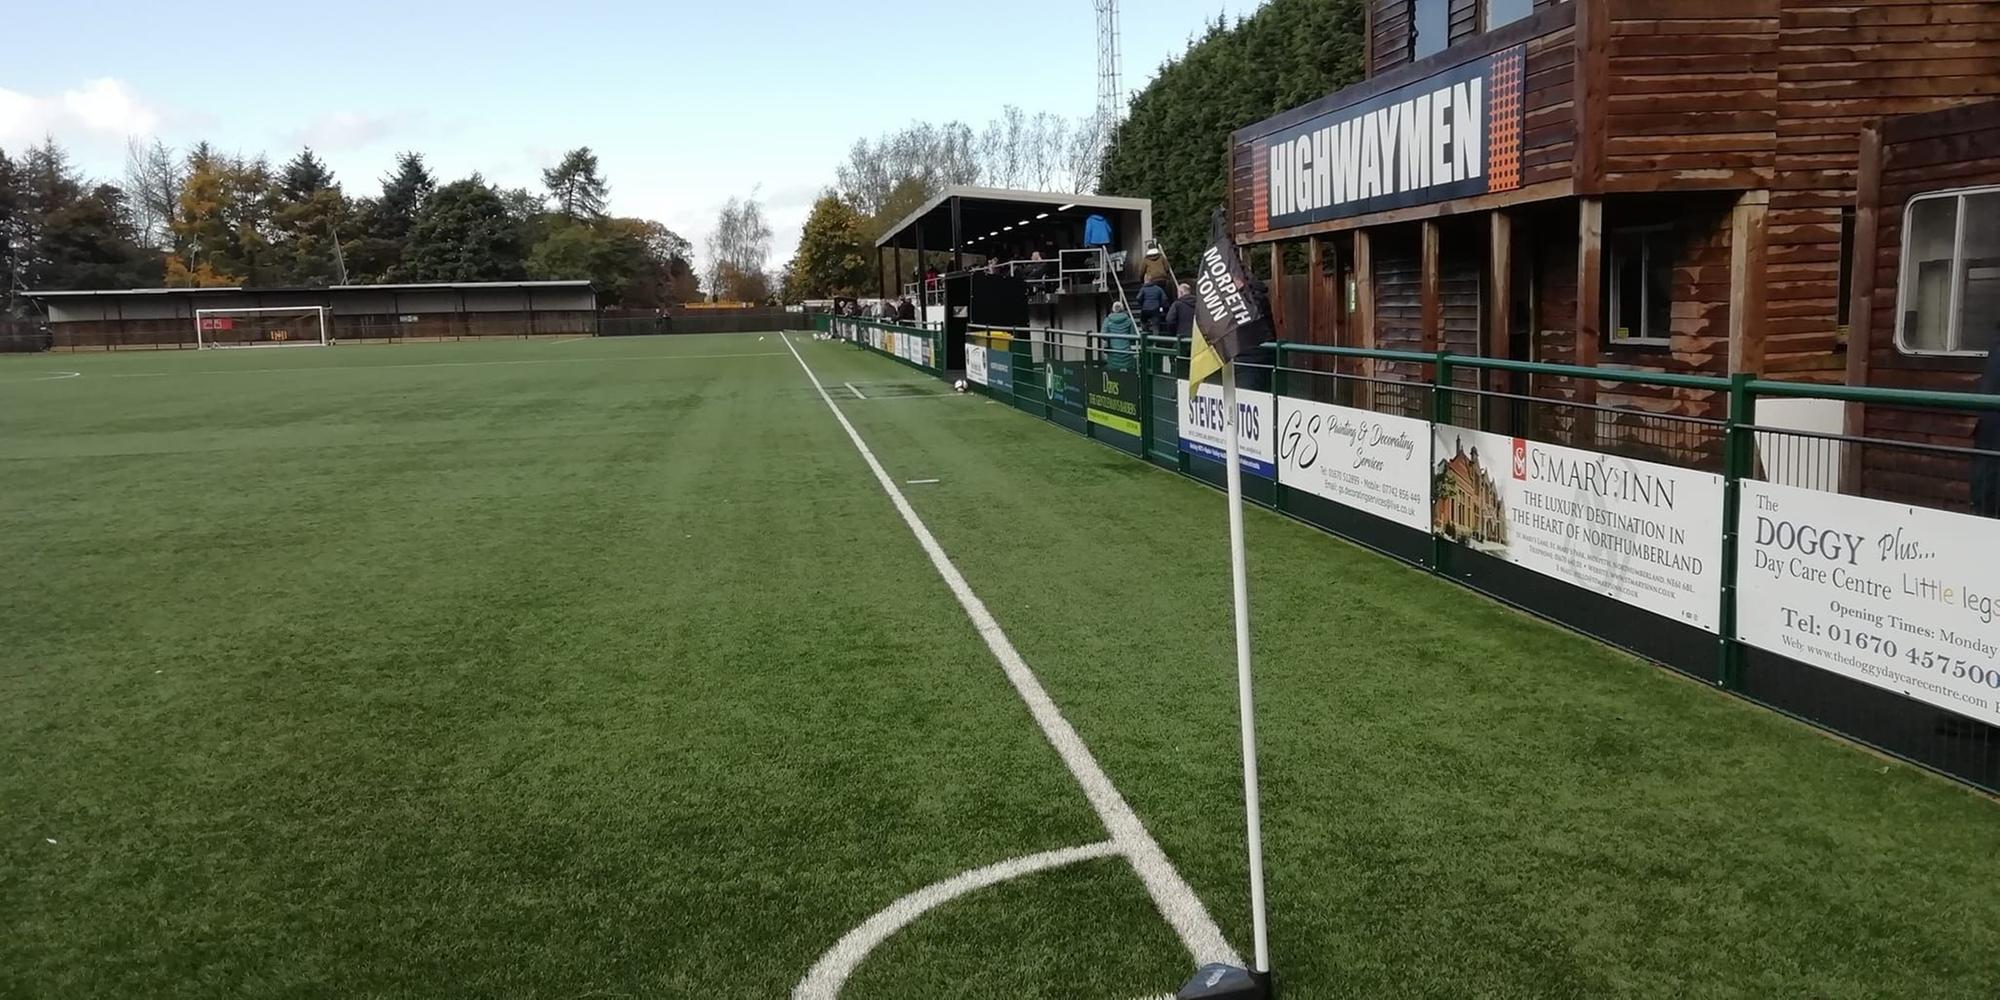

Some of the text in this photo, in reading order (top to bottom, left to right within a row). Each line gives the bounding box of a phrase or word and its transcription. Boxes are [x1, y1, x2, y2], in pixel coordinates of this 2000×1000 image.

[1270, 76, 1483, 217] HIGHWAYMEN
[1197, 270, 1228, 322] TOWN
[1203, 246, 1251, 325] MORPETH
[1188, 395, 1224, 432] STEVE'S
[1281, 410, 1321, 470] GS
[1327, 414, 1356, 447] Painting
[1370, 423, 1414, 461] Decorating
[1353, 447, 1384, 471] Services
[1523, 490, 1685, 545] THE LUXURY DESTINATION IN
[1756, 494, 1779, 512] The
[1512, 507, 1530, 526] THE
[1532, 513, 1564, 535] HEART
[1566, 522, 1580, 540] OF
[1583, 528, 1703, 575] NORTHUMBERLAND
[1755, 516, 1865, 566] DOGGY
[1755, 549, 1785, 579] Day
[1789, 557, 1827, 584] Care
[1832, 567, 1892, 600] Centre
[1903, 572, 1954, 605] Little
[1781, 607, 2000, 689] Tel: 01670 457500
[1830, 600, 1998, 660] Opening Times: Monday
[1807, 645, 1988, 709] www.thedoggydaycarecentre.com
